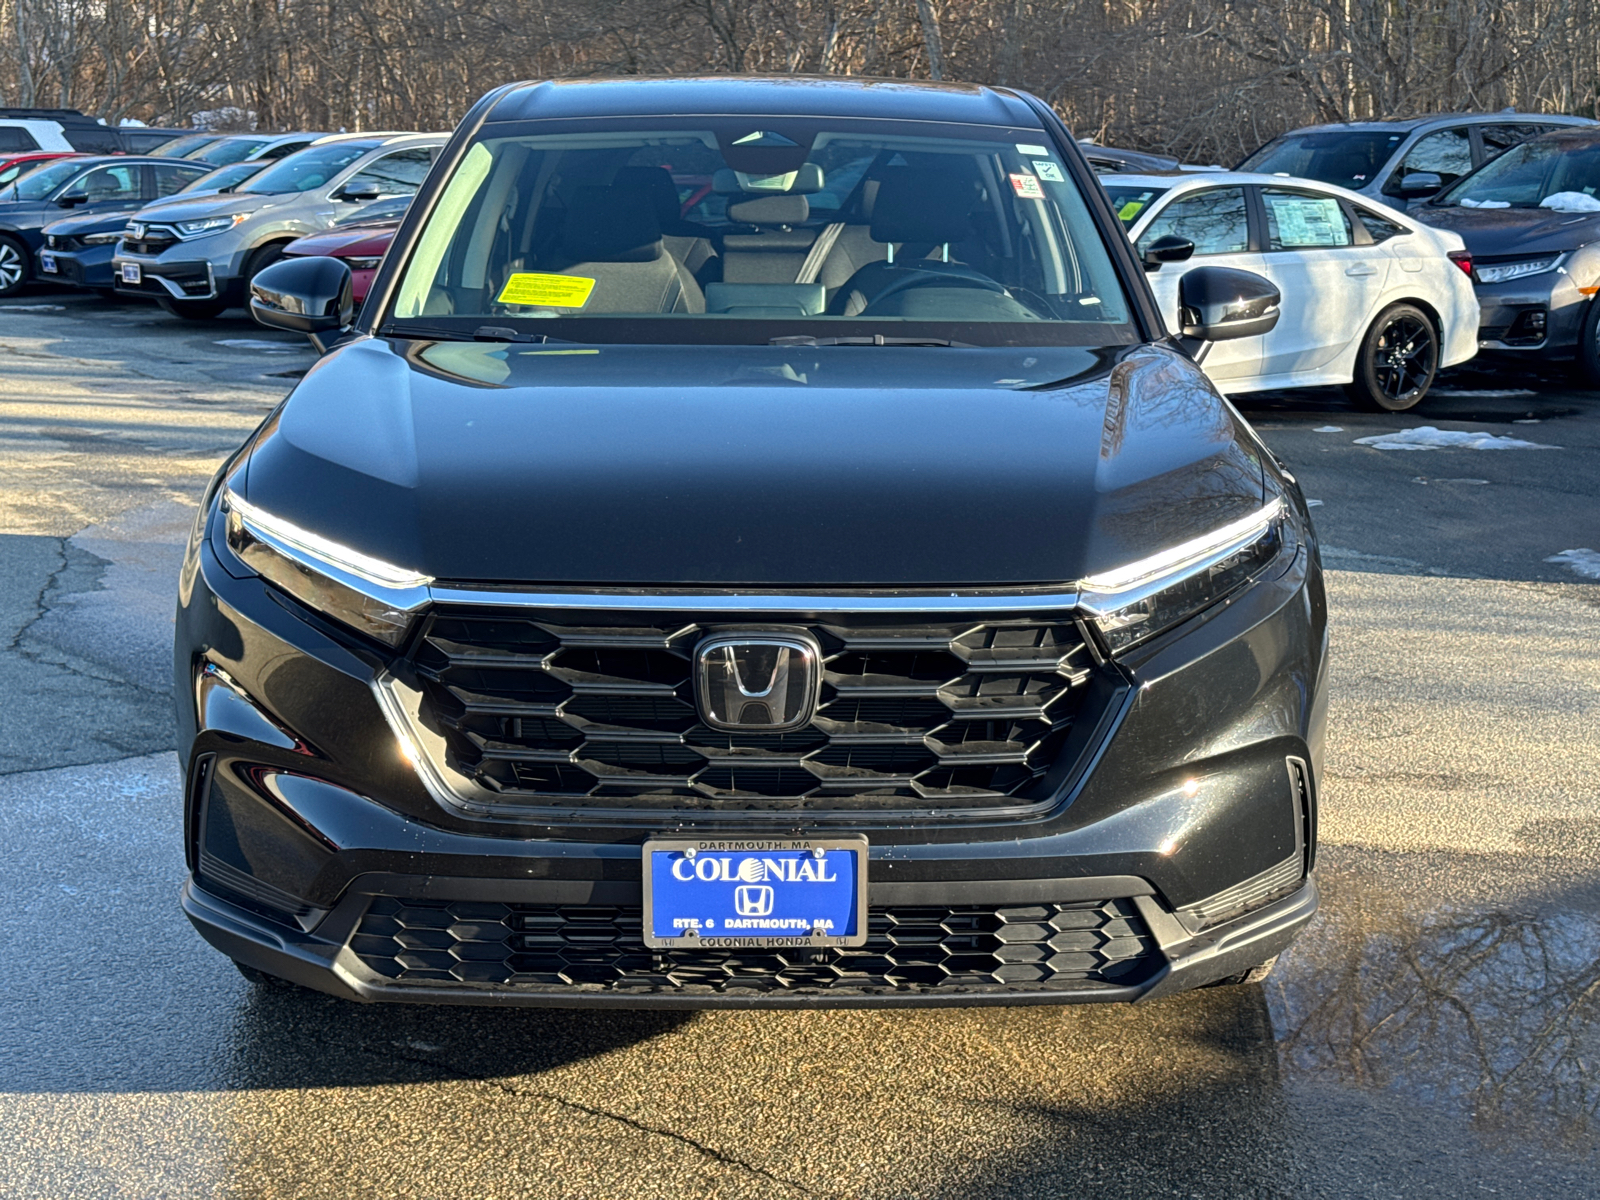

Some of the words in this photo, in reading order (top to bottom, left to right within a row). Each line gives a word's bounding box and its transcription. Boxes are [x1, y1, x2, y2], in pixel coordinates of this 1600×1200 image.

[791, 841, 811, 849] MA
[672, 857, 837, 883] COLONIAL
[673, 918, 703, 928] RTE.
[705, 918, 715, 928] 6
[724, 918, 811, 930] DARTMOUTH,
[813, 919, 835, 929] MA
[699, 937, 763, 947] COLONIAL
[766, 937, 812, 946] HONDA
